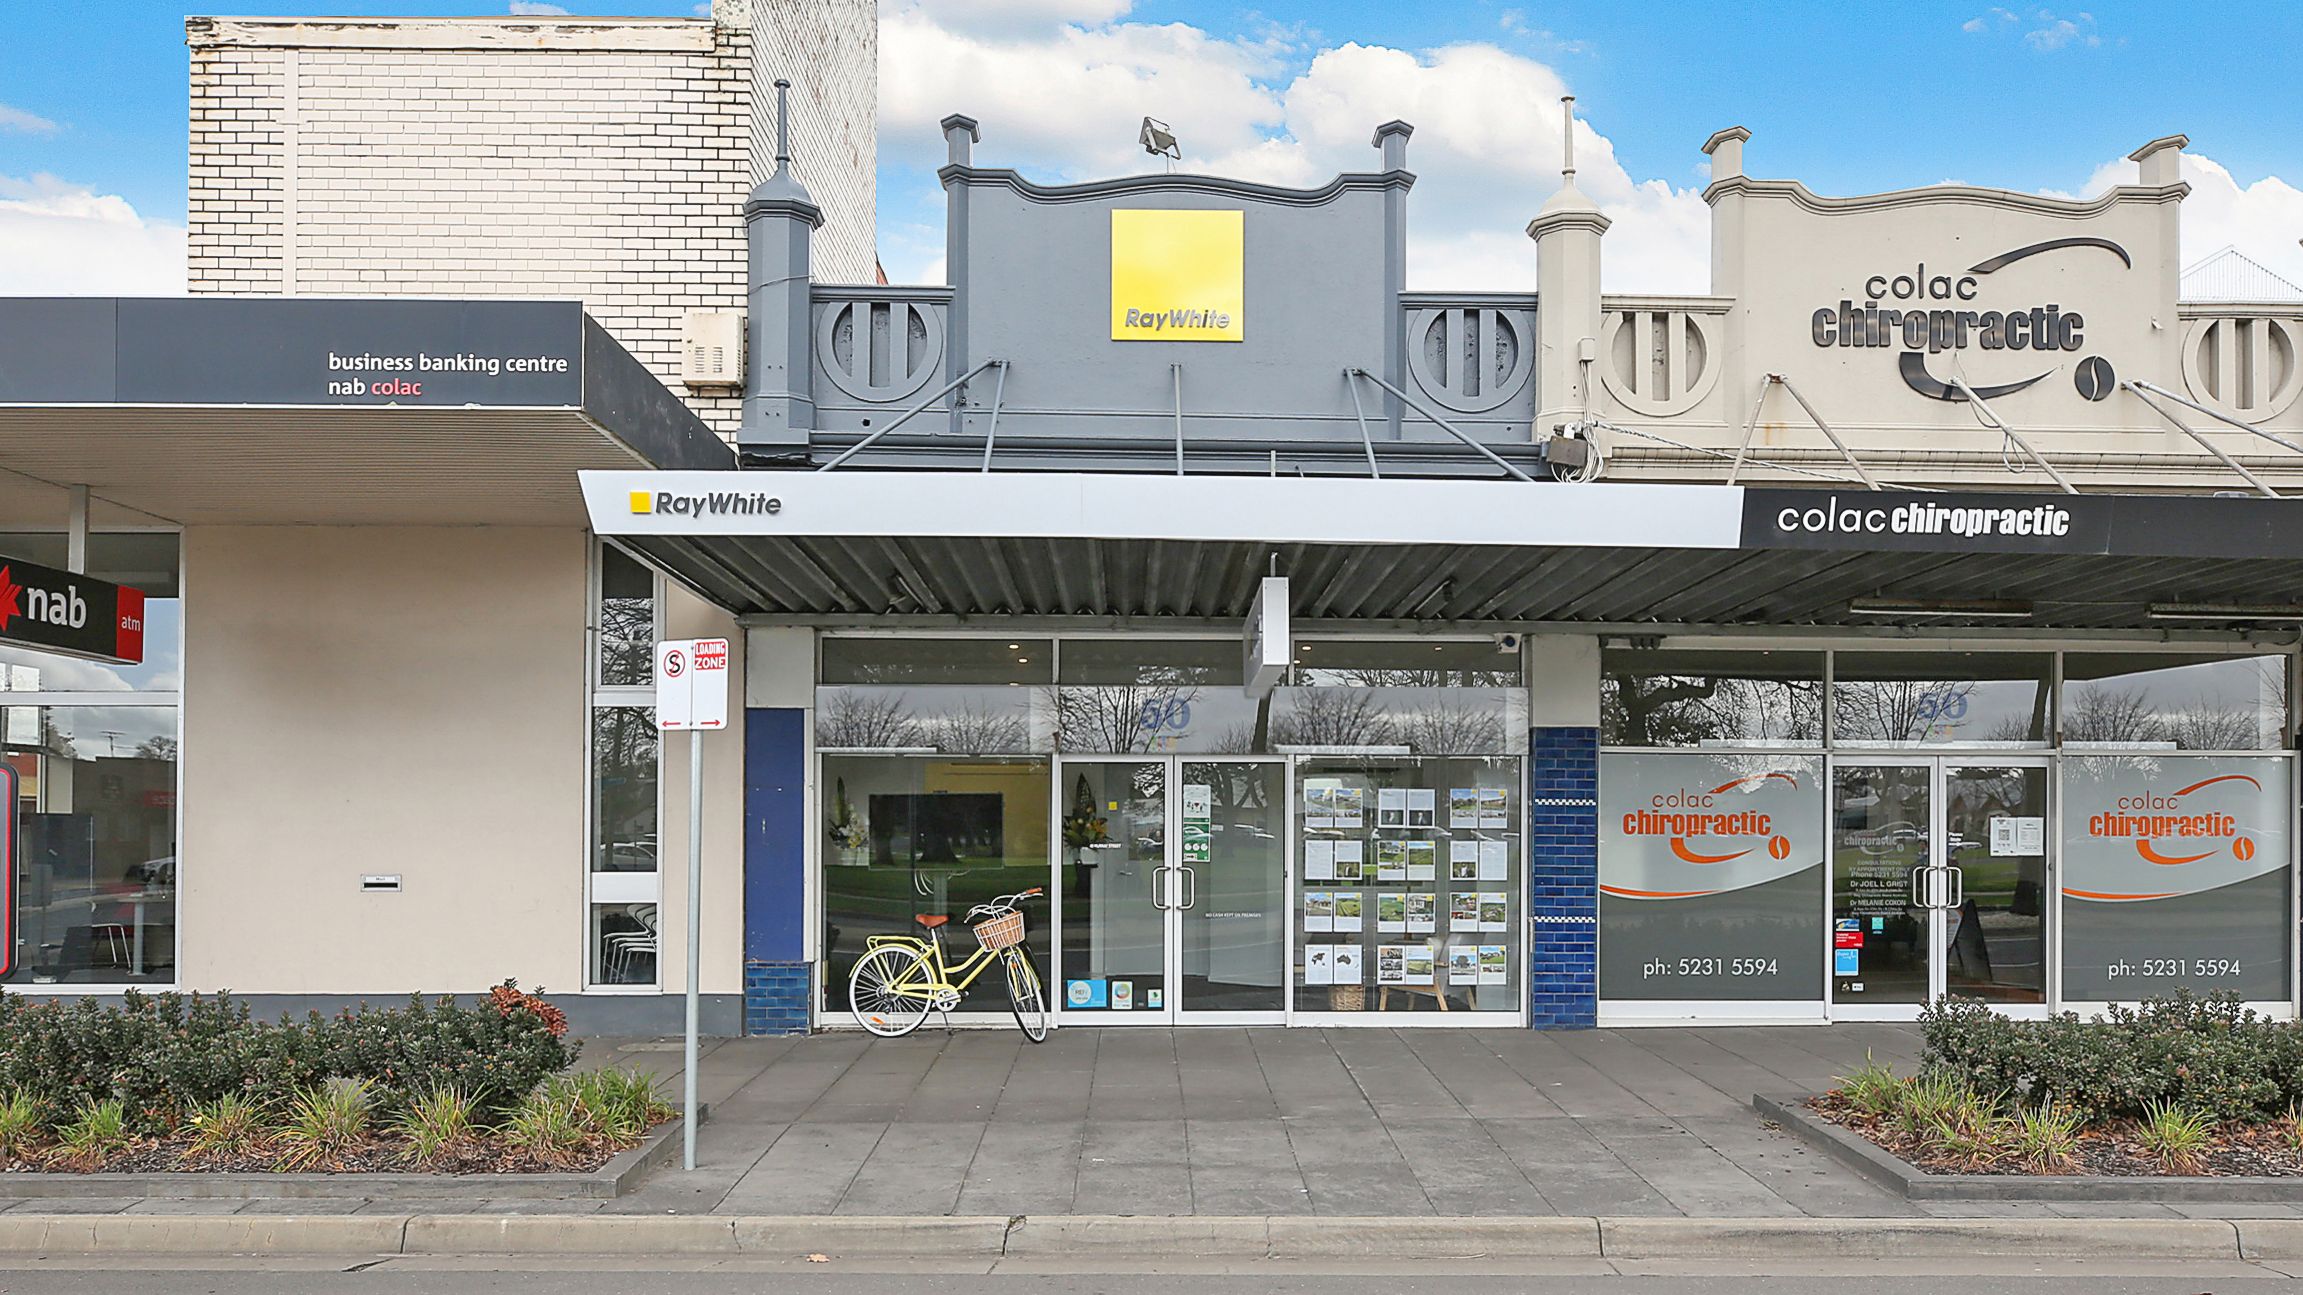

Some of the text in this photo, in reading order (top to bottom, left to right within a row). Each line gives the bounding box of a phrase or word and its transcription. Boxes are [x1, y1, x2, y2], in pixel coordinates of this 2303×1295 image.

[1865, 262, 1978, 300] colac
[1125, 308, 1231, 332] RayWhite
[1811, 299, 2085, 354] chiropractic
[328, 352, 569, 376] business banking centre
[328, 377, 423, 396] nab colac
[655, 491, 782, 519] RayWhite
[1776, 496, 2071, 538] colac chiropractic
[27, 584, 87, 630] nab
[121, 614, 141, 632] atm
[695, 642, 726, 655] LOADING
[695, 656, 725, 669] ZONE
[1652, 787, 1714, 808] colac
[2117, 789, 2179, 810] colac
[1622, 809, 1772, 838] chiropractic
[2088, 811, 2236, 840] chiropractic
[1850, 880, 1859, 888] Dr
[1860, 880, 1879, 888] JOEL
[1643, 957, 1778, 980] ph: 5231 5594
[2108, 958, 2241, 981] ph: 5231 5594
